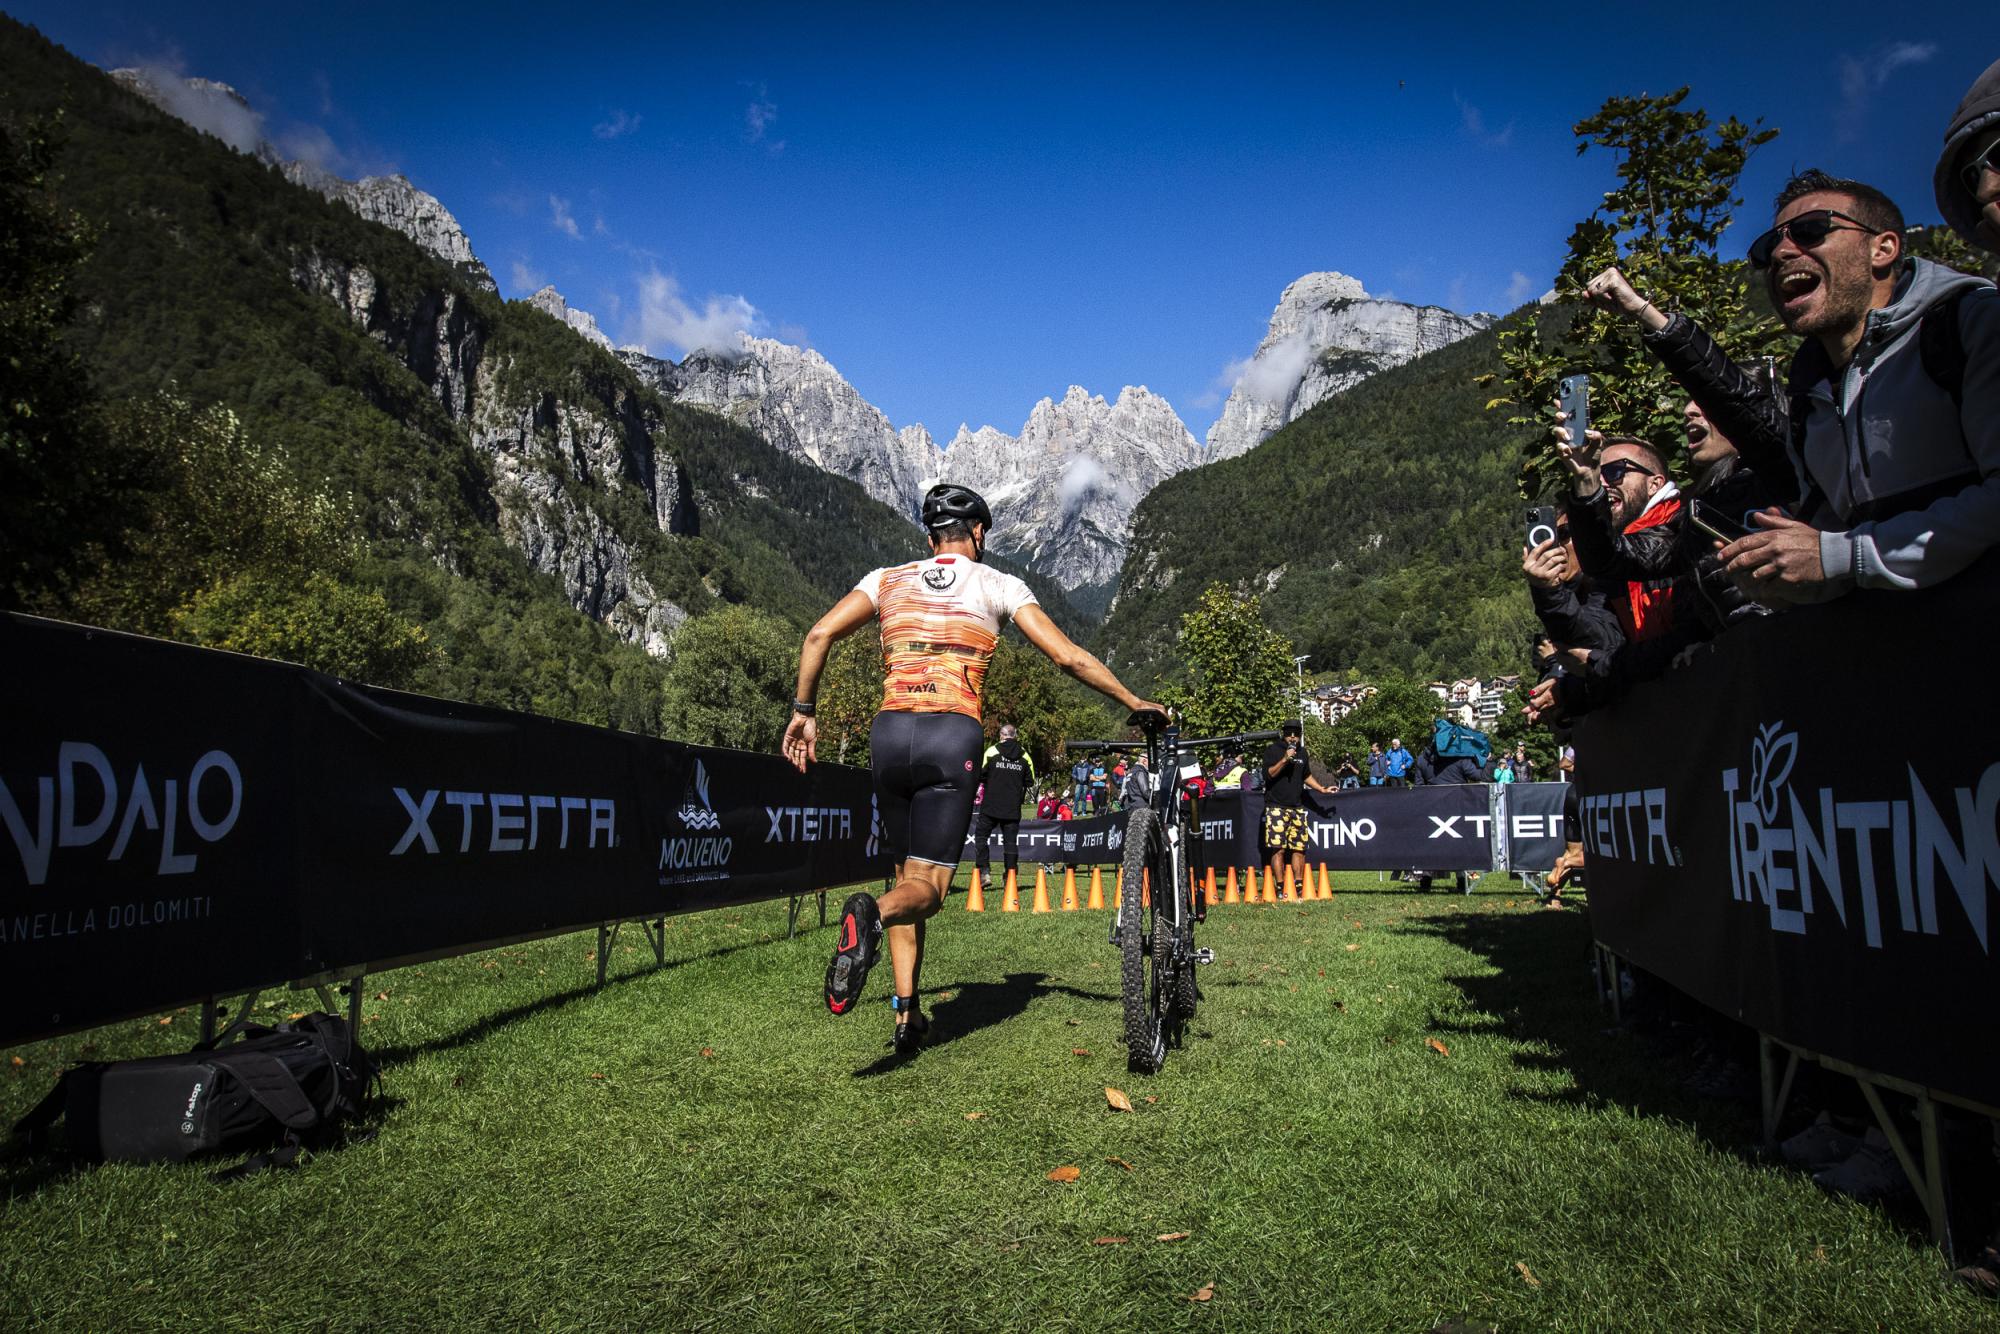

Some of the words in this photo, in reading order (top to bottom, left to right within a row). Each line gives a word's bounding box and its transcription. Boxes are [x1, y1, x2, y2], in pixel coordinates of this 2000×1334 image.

[907, 683, 937, 693] YAYA
[388, 787, 615, 855] XTERRA
[764, 806, 851, 843] XTERRA
[658, 836, 733, 870] MOLVENO
[108, 896, 211, 929] DOLOMITI
